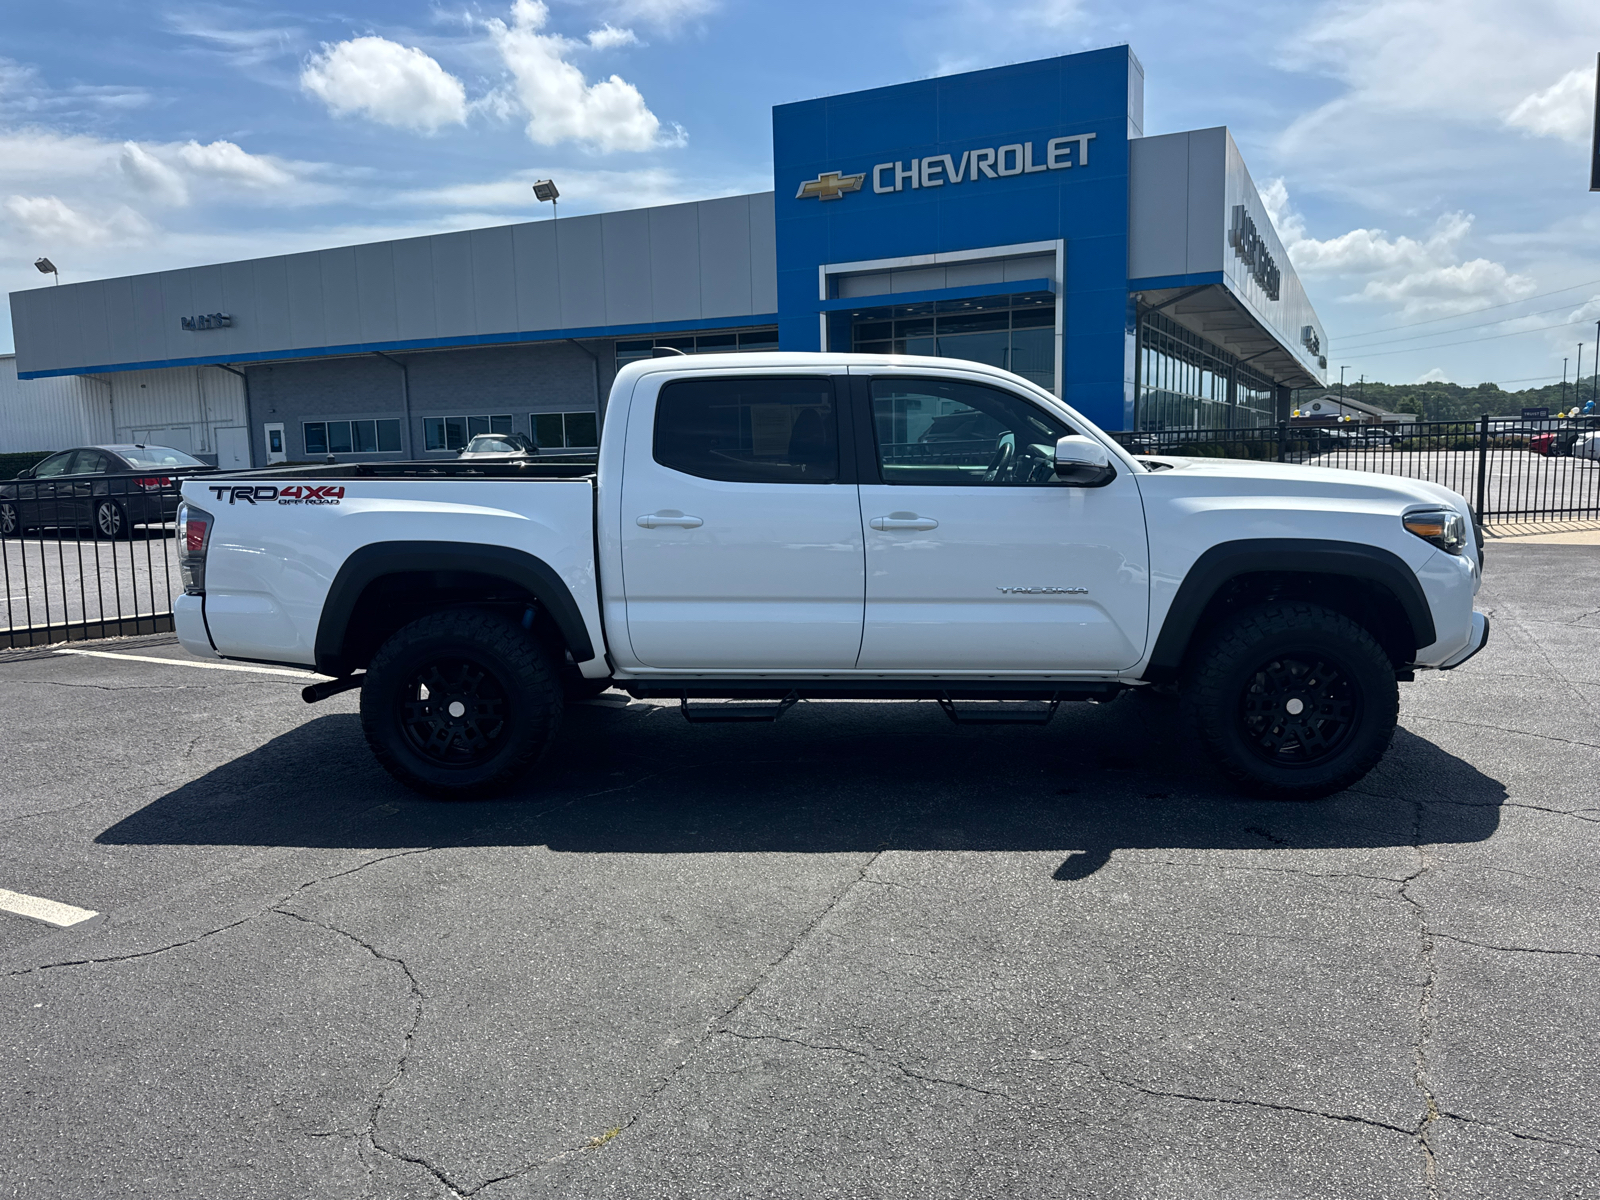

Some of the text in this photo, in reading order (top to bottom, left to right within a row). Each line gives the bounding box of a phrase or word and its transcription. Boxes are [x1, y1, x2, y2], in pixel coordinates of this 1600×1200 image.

[873, 133, 1096, 194] CHEVROLET
[181, 312, 223, 331] PARTS
[209, 486, 279, 505] TRD
[996, 586, 1089, 594] TACOMA
